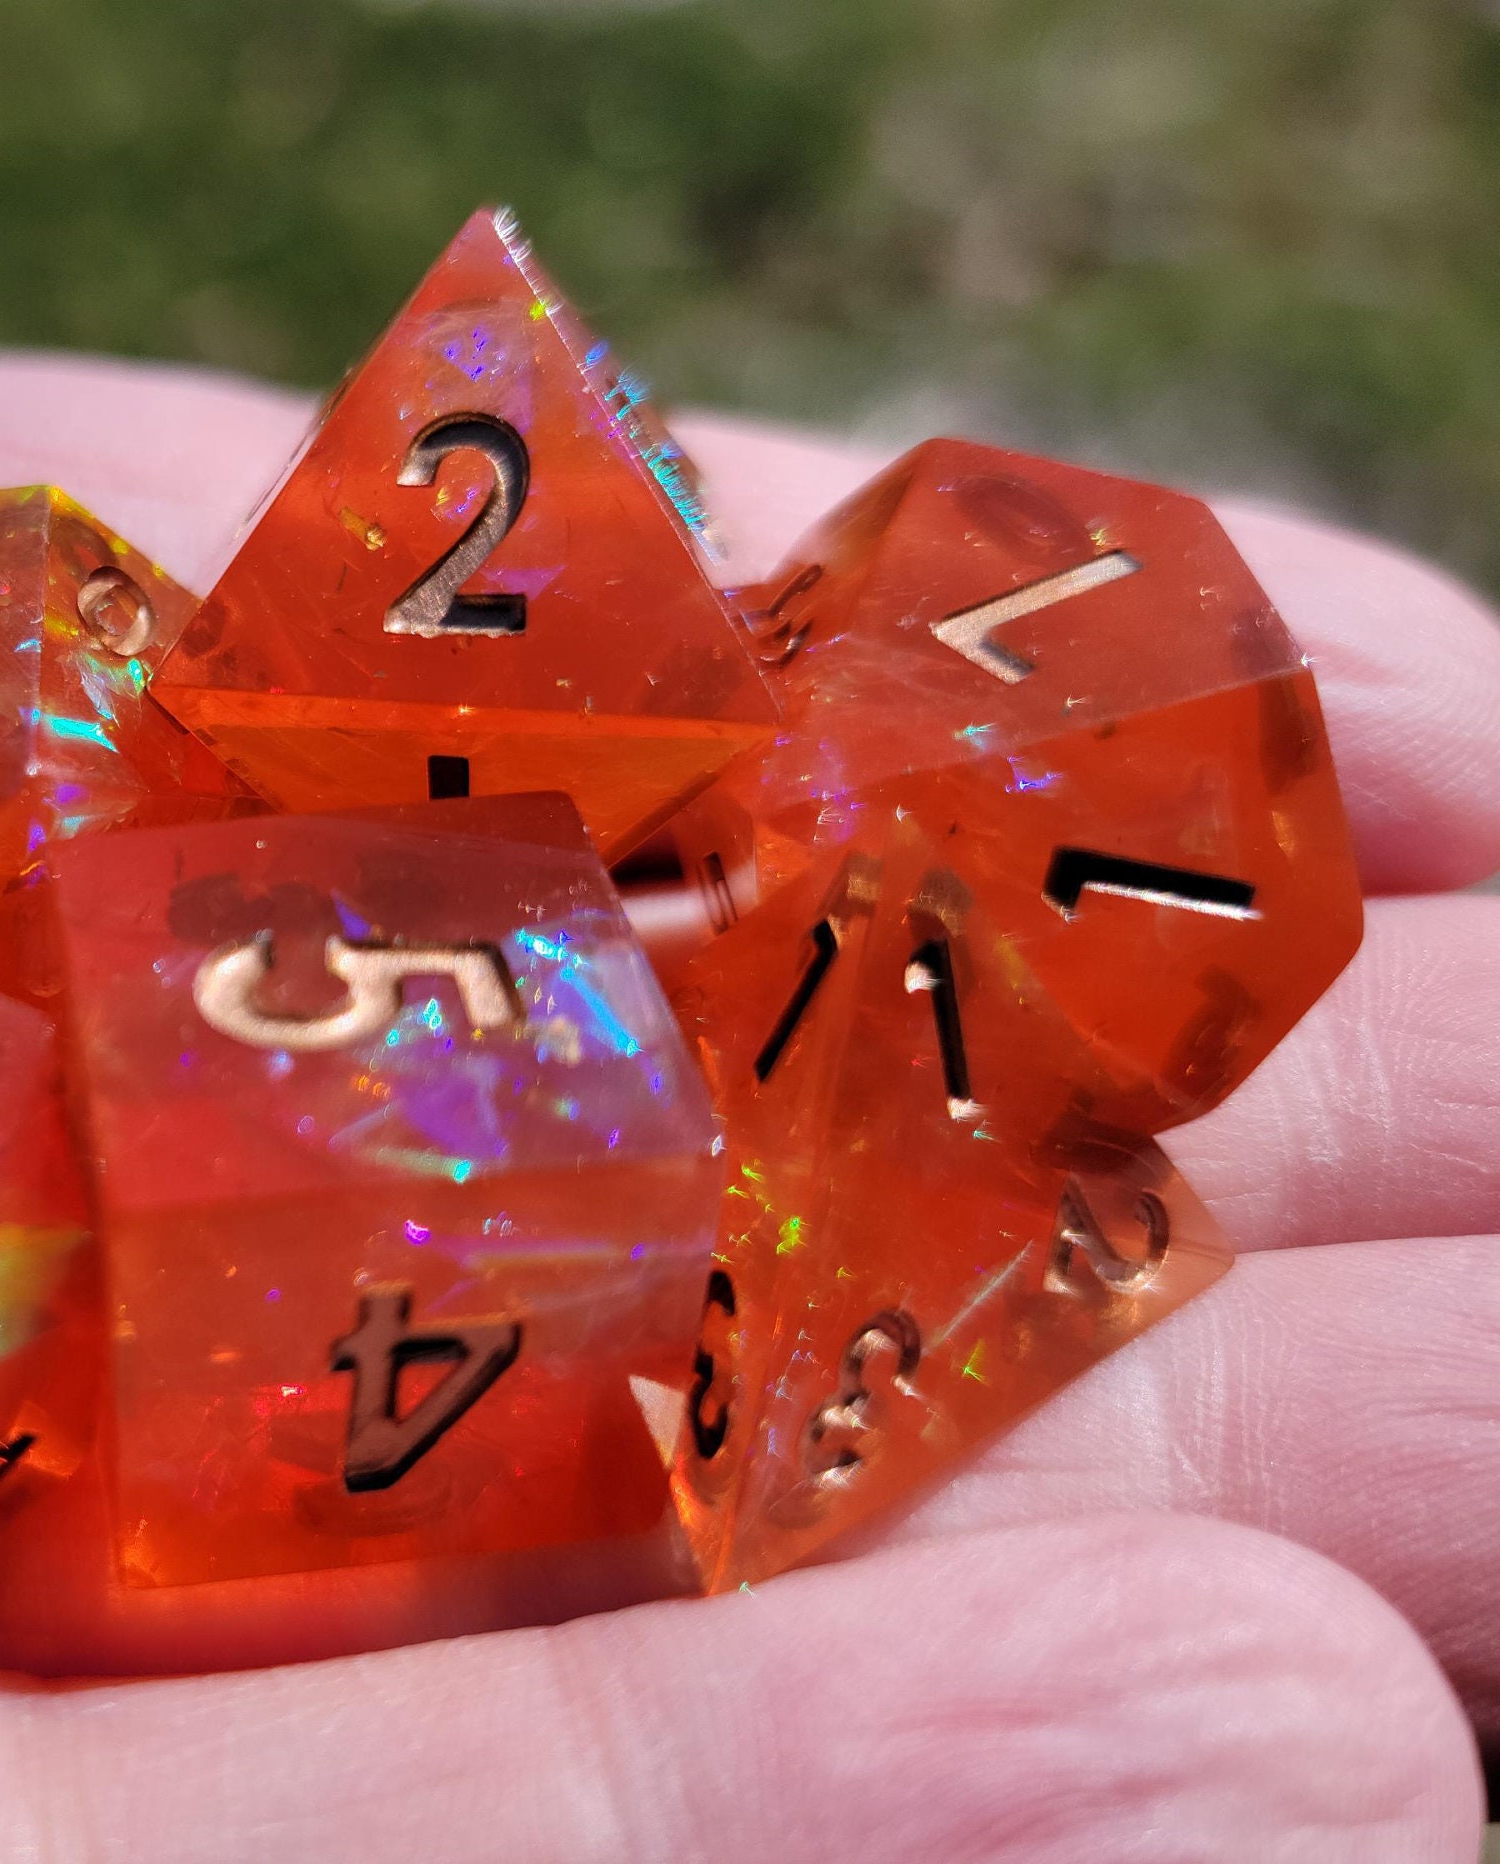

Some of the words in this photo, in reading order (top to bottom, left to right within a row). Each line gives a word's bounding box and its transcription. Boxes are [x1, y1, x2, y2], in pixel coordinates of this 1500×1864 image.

[383, 411, 531, 637] 2
[193, 935, 526, 1052] 5
[331, 1282, 523, 1494] 4
